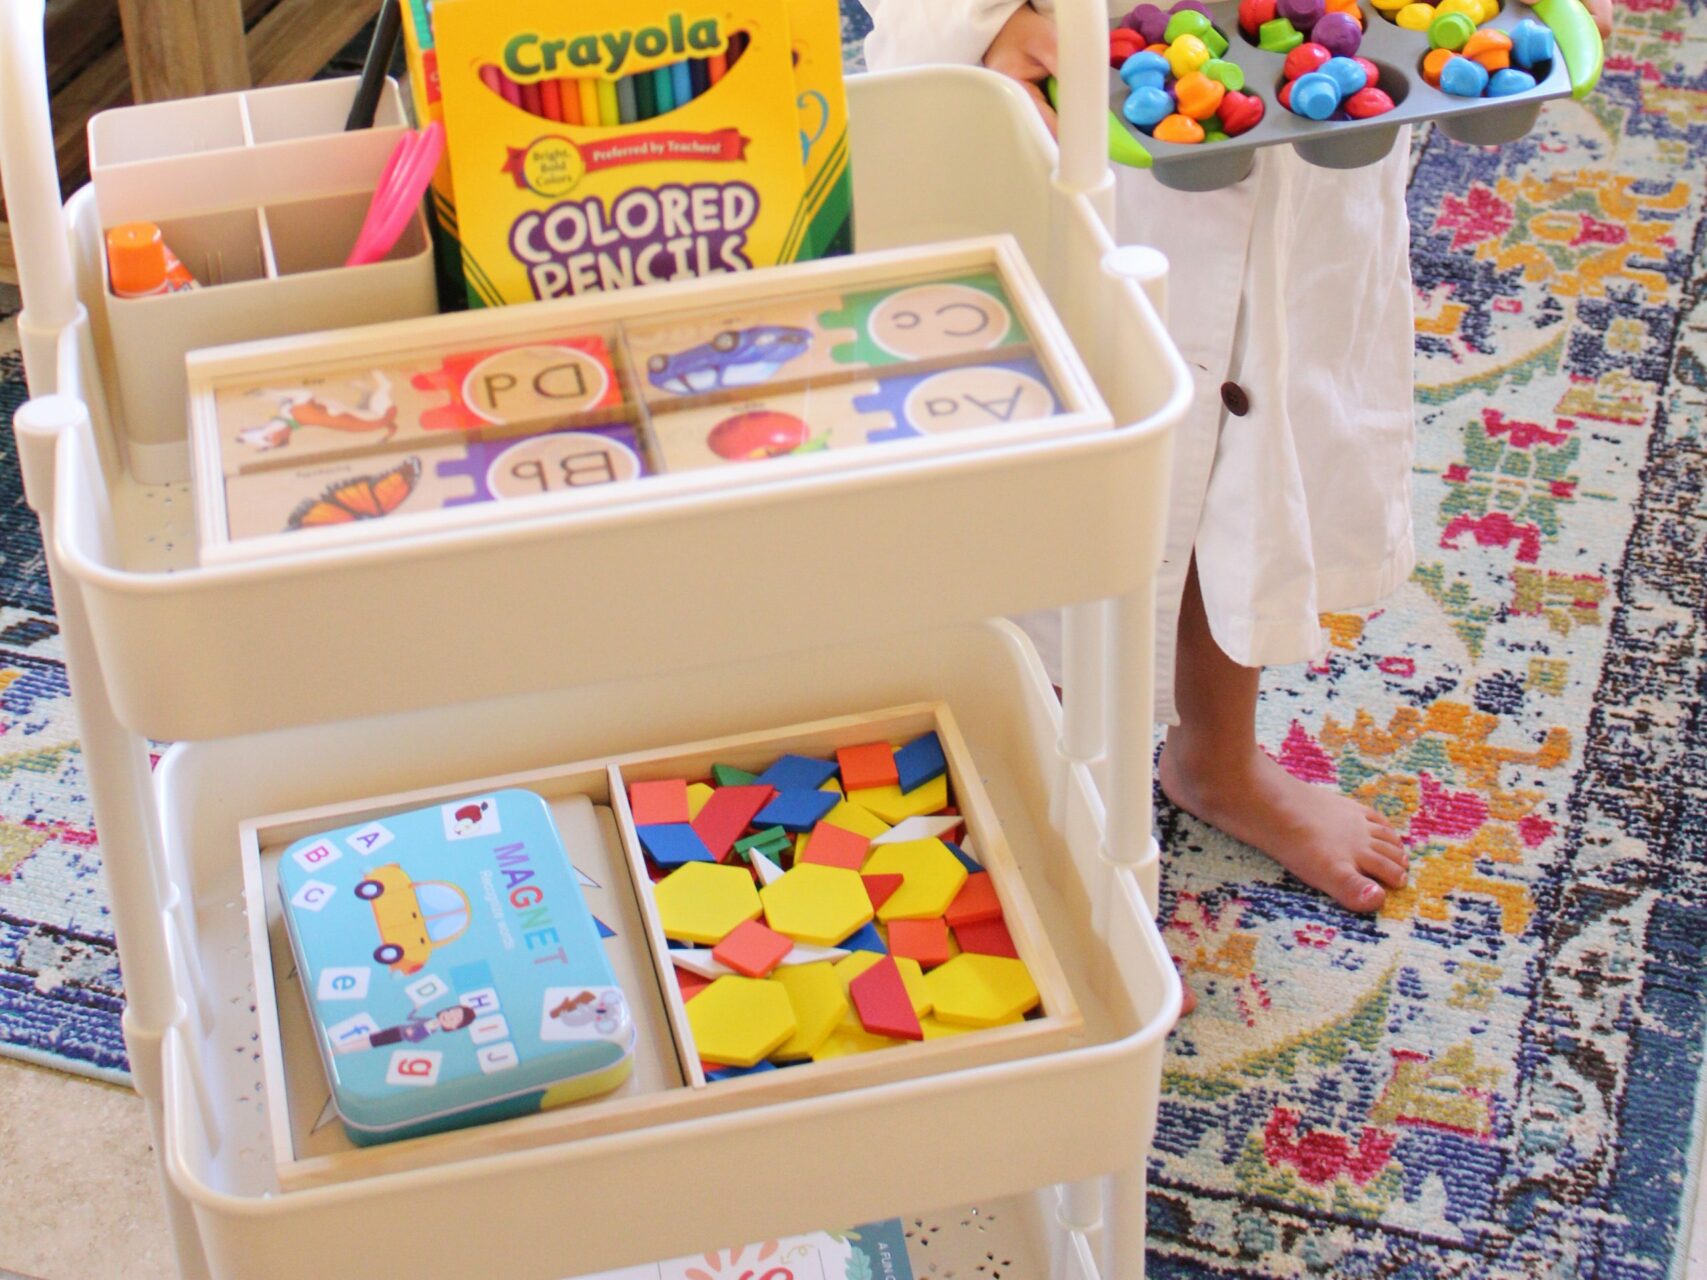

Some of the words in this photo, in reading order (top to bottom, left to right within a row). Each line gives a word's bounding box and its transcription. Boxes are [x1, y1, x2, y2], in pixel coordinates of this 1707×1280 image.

[504, 15, 721, 72] Crayola
[593, 142, 648, 161] Preferred
[650, 139, 664, 154] by
[667, 140, 721, 154] Teachers!
[540, 161, 567, 173] Bold
[535, 175, 572, 187] Colors
[513, 187, 756, 261] COLORED
[531, 236, 747, 300] PENCILS
[357, 830, 380, 848] A
[304, 846, 329, 863] B
[303, 887, 325, 903] C
[493, 842, 568, 965] MAGNET
[332, 974, 356, 991] e
[416, 982, 437, 997] D
[468, 995, 492, 1010] H
